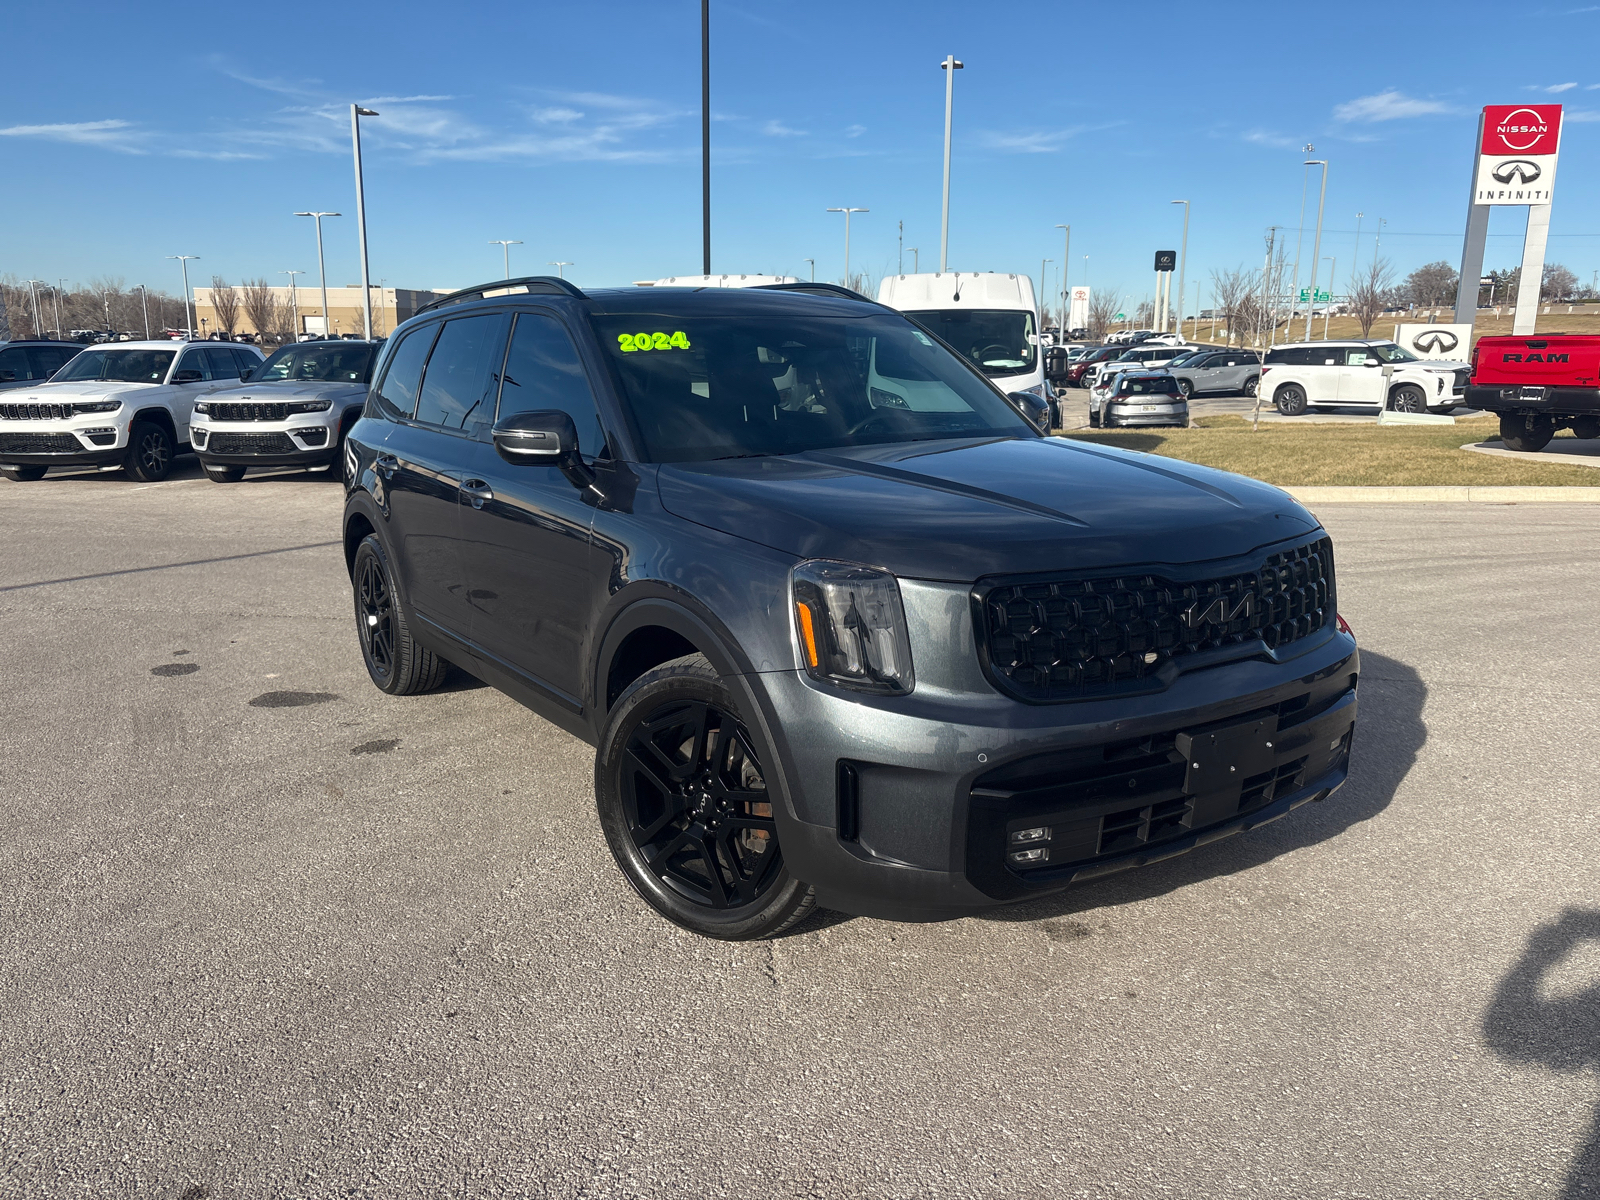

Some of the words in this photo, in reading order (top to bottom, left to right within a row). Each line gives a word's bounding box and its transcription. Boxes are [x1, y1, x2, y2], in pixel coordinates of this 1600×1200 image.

[1479, 191, 1549, 199] INFINITI
[617, 331, 691, 352] 2024
[1502, 353, 1570, 363] RAM
